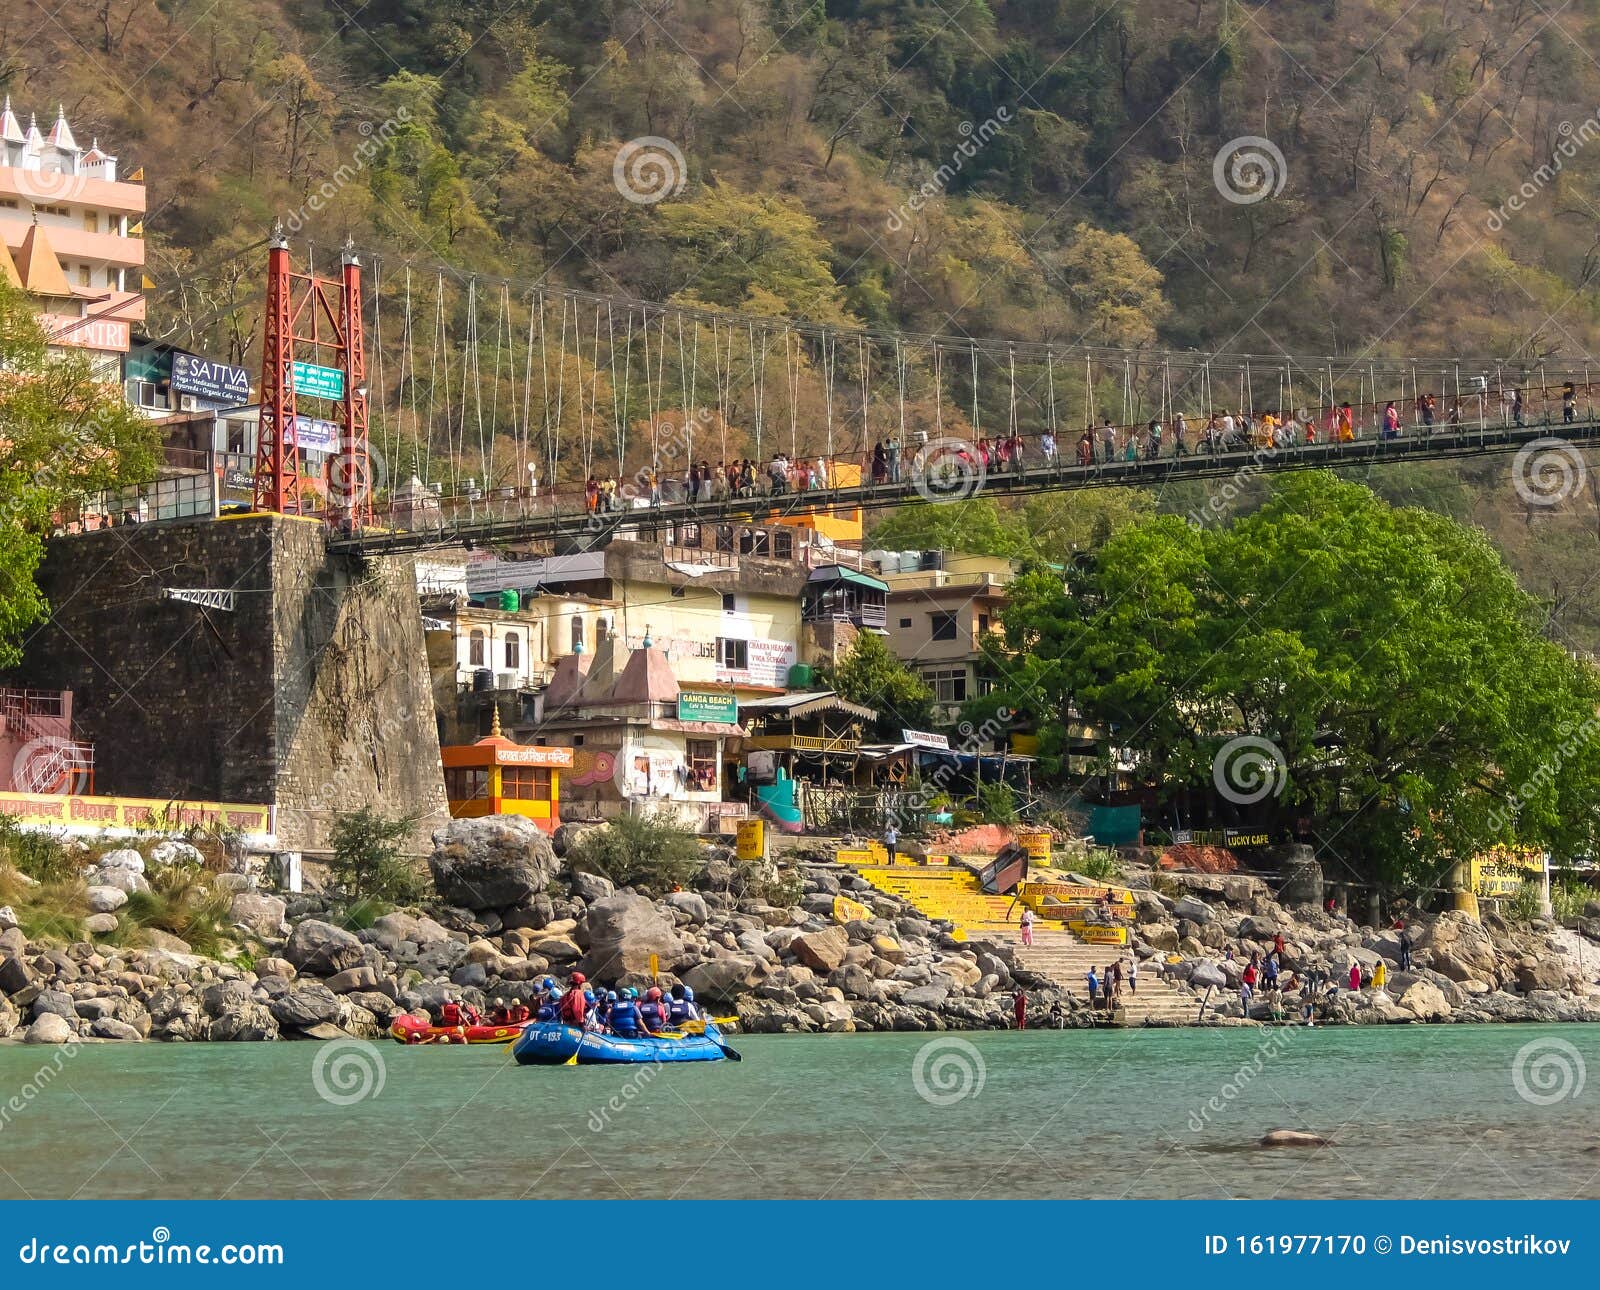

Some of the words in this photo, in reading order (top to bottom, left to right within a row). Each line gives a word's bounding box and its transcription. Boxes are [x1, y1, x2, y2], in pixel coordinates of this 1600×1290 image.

[190, 359, 249, 388] SATTVA
[683, 694, 707, 704] GANGA
[708, 695, 732, 705] BEACH
[1227, 836, 1250, 847] LUCKY
[1251, 834, 1269, 844] CAFE
